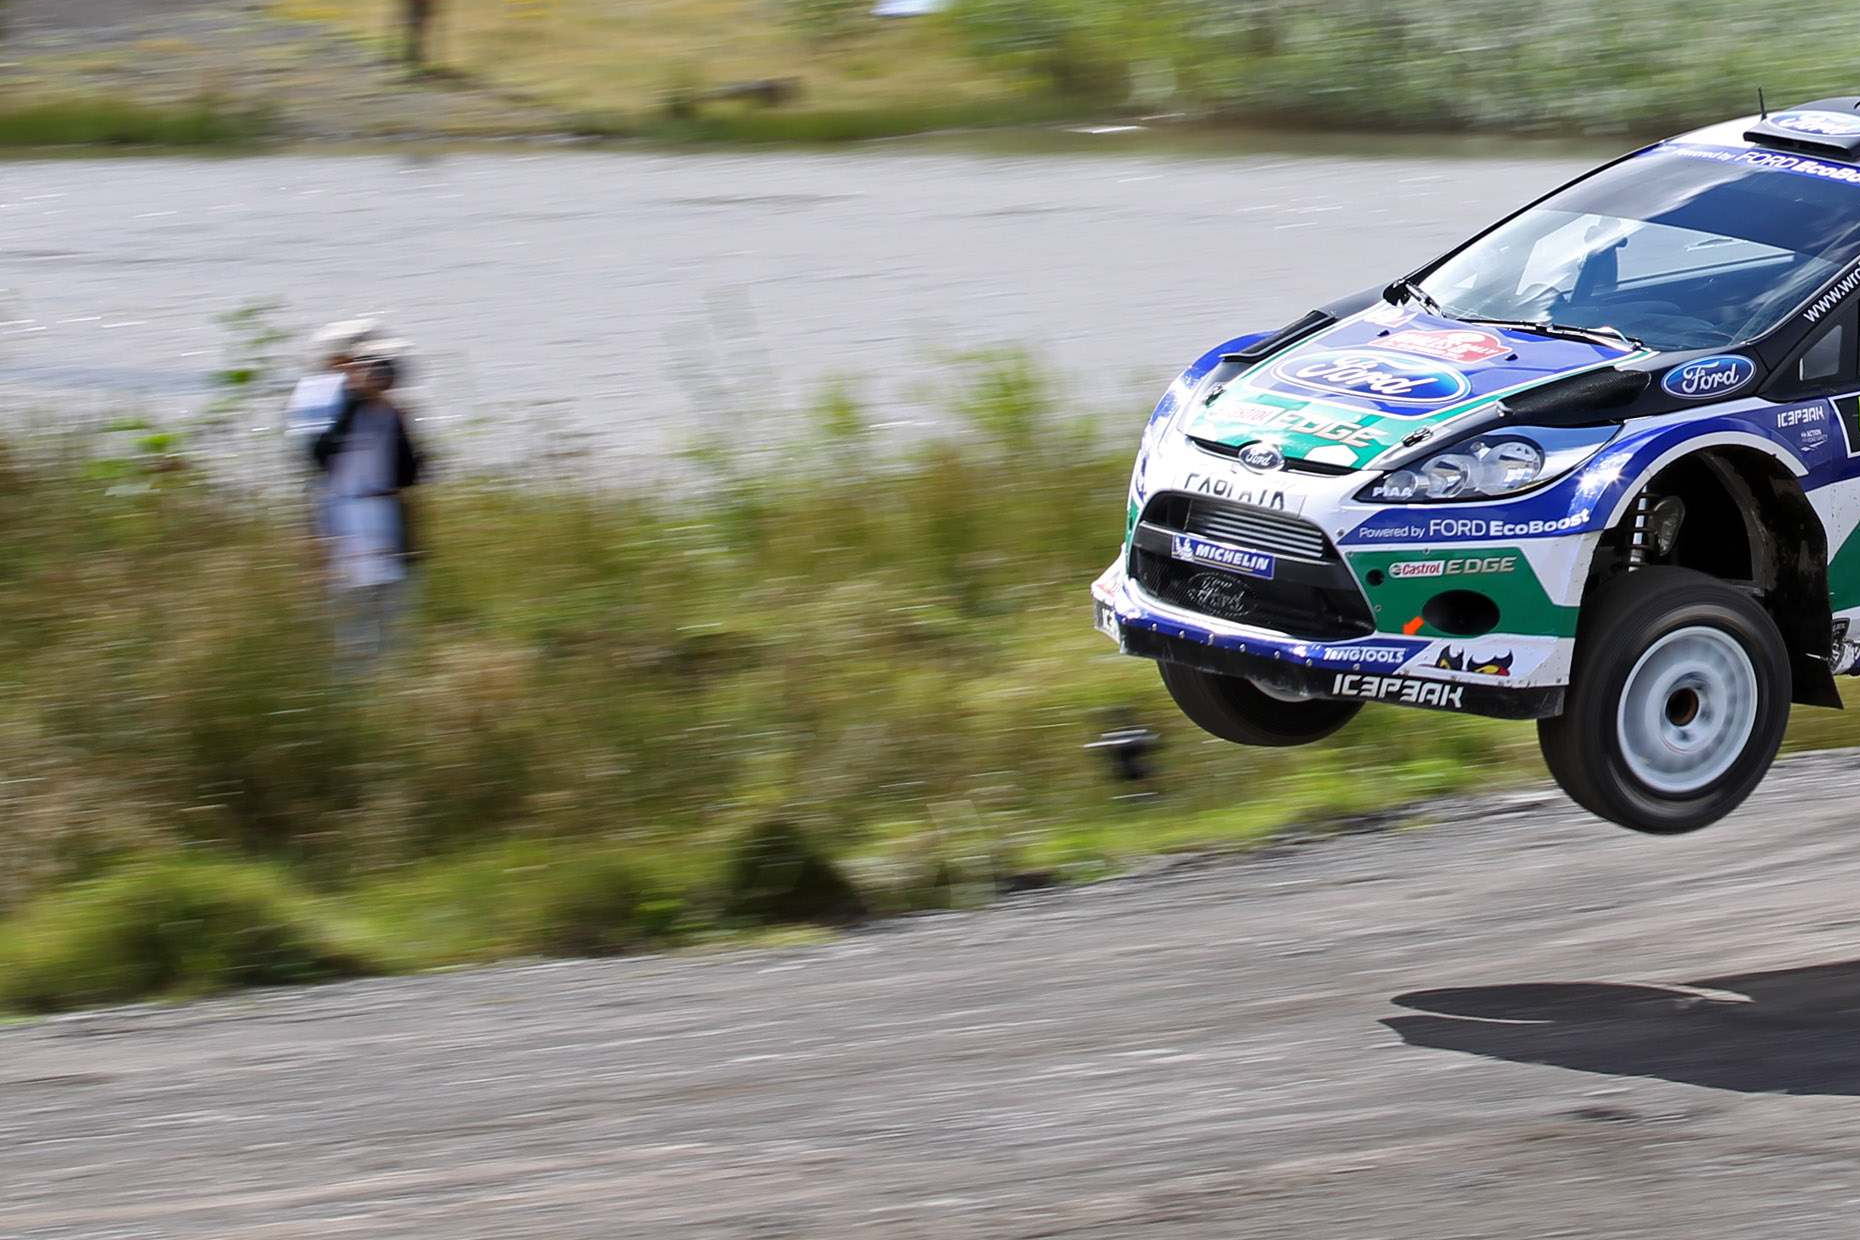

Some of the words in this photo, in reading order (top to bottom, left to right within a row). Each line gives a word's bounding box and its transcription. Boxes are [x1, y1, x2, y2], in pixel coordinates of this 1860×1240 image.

[1779, 114, 1860, 136] Ford
[1735, 151, 1799, 170] FORD
[1296, 355, 1439, 396] Ford
[1682, 361, 1740, 396] Ford
[1275, 410, 1390, 448] EDGE
[1246, 449, 1272, 467] Ford
[1372, 486, 1413, 498] PIAA
[1359, 526, 1408, 539] Powered
[1410, 525, 1425, 539] by
[1429, 520, 1487, 536] FORD
[1489, 508, 1590, 536] EcoBoost
[1195, 543, 1270, 571] MICHELIN
[1402, 563, 1442, 575] Castrol
[1445, 556, 1518, 575] EDGE
